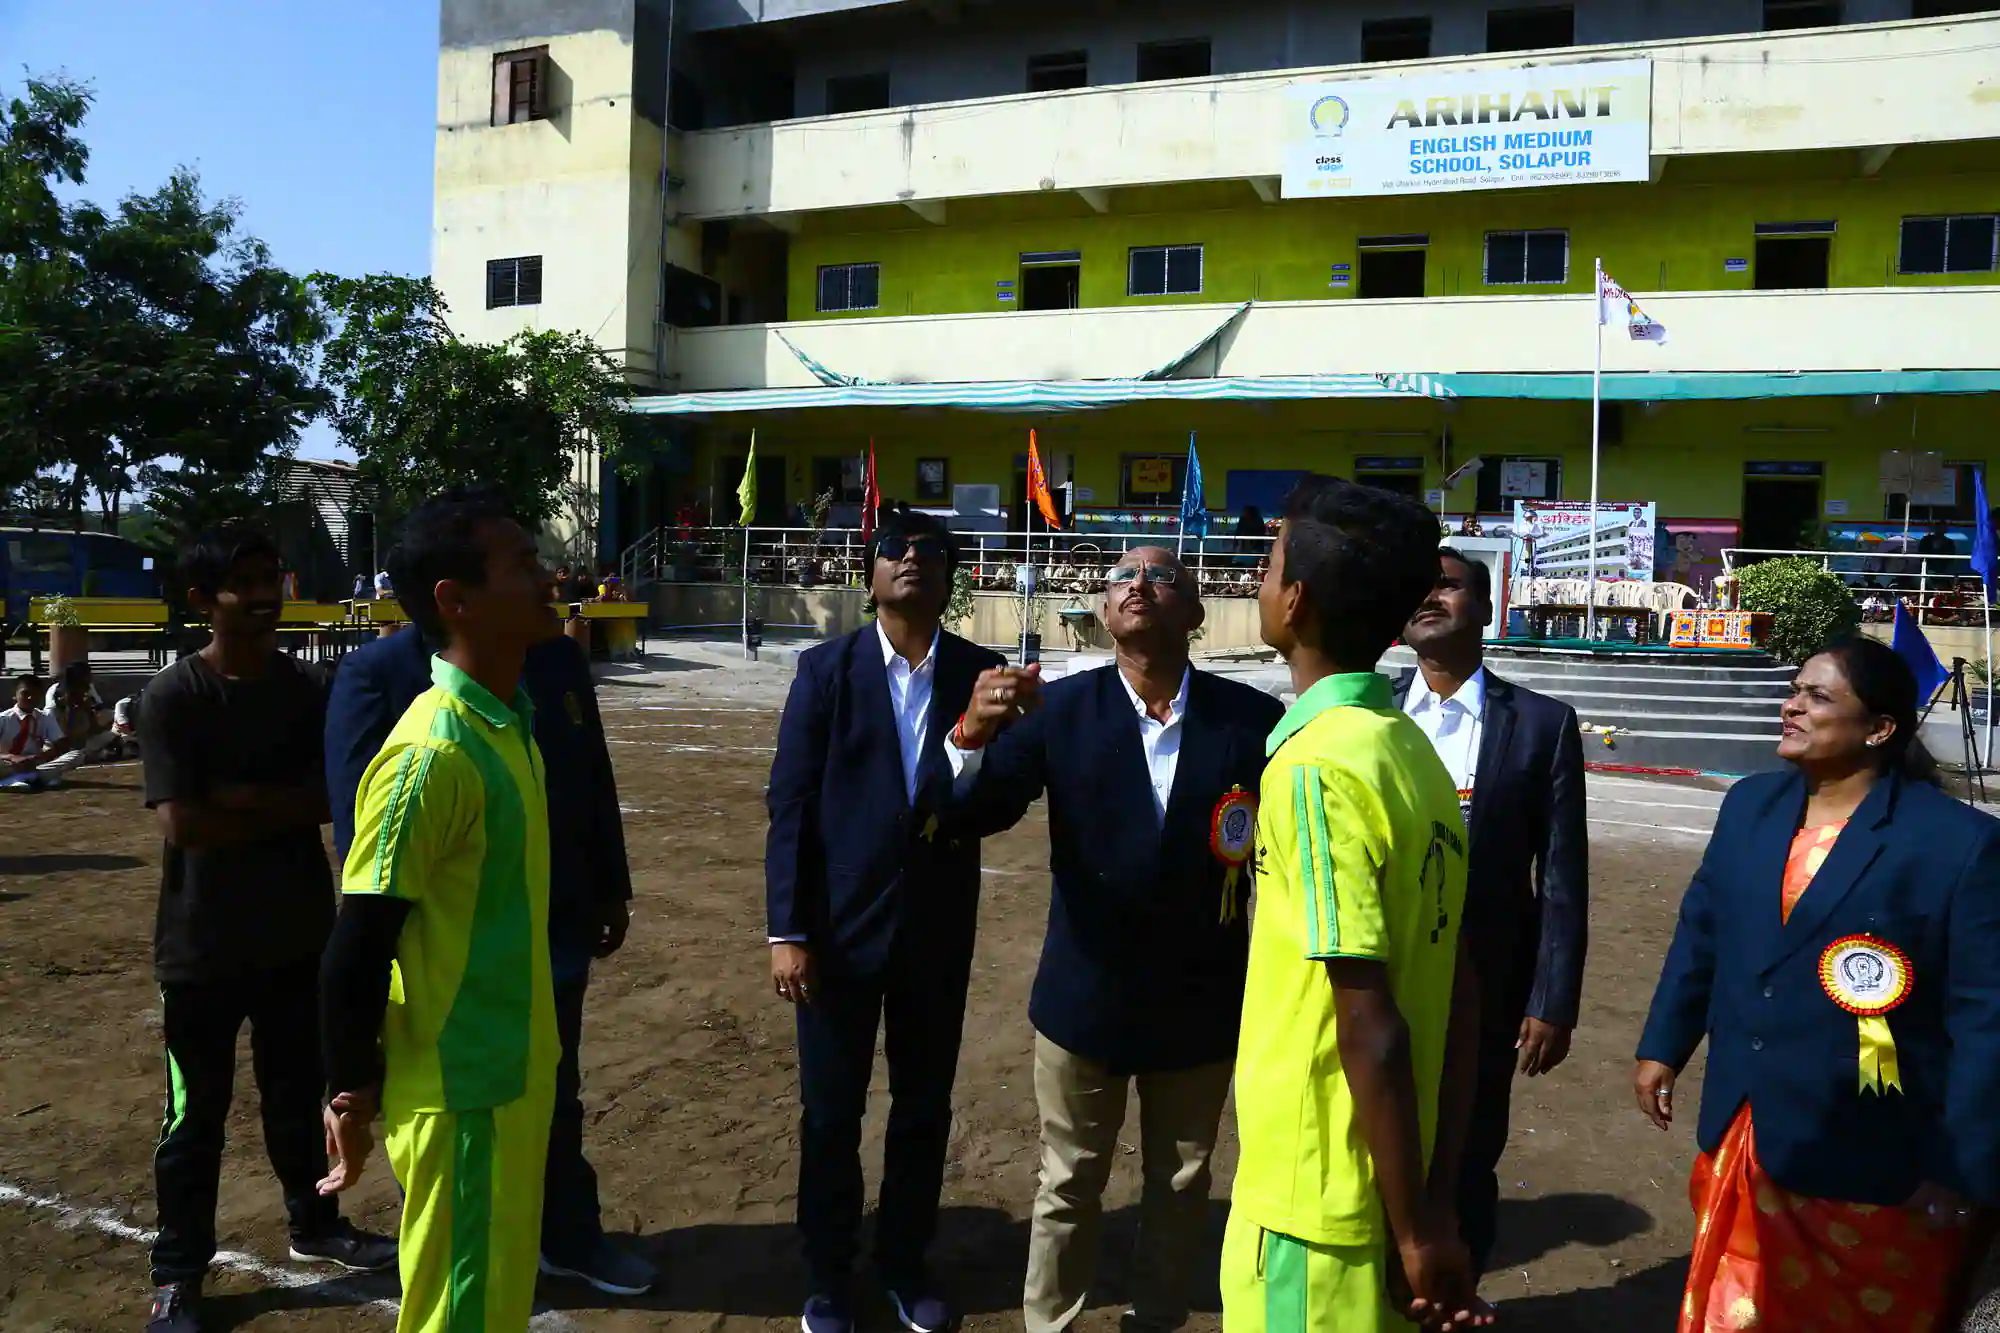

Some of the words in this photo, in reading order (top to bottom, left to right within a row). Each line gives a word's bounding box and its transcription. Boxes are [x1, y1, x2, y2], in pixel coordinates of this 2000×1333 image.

[1386, 86, 1620, 129] ARIHANT
[1410, 135, 1496, 155] ENGLISH
[1504, 130, 1592, 149] MEDIUM
[1315, 155, 1341, 164] class
[1410, 155, 1492, 174] SCHOOL,
[1499, 151, 1592, 170] SOLAPUR
